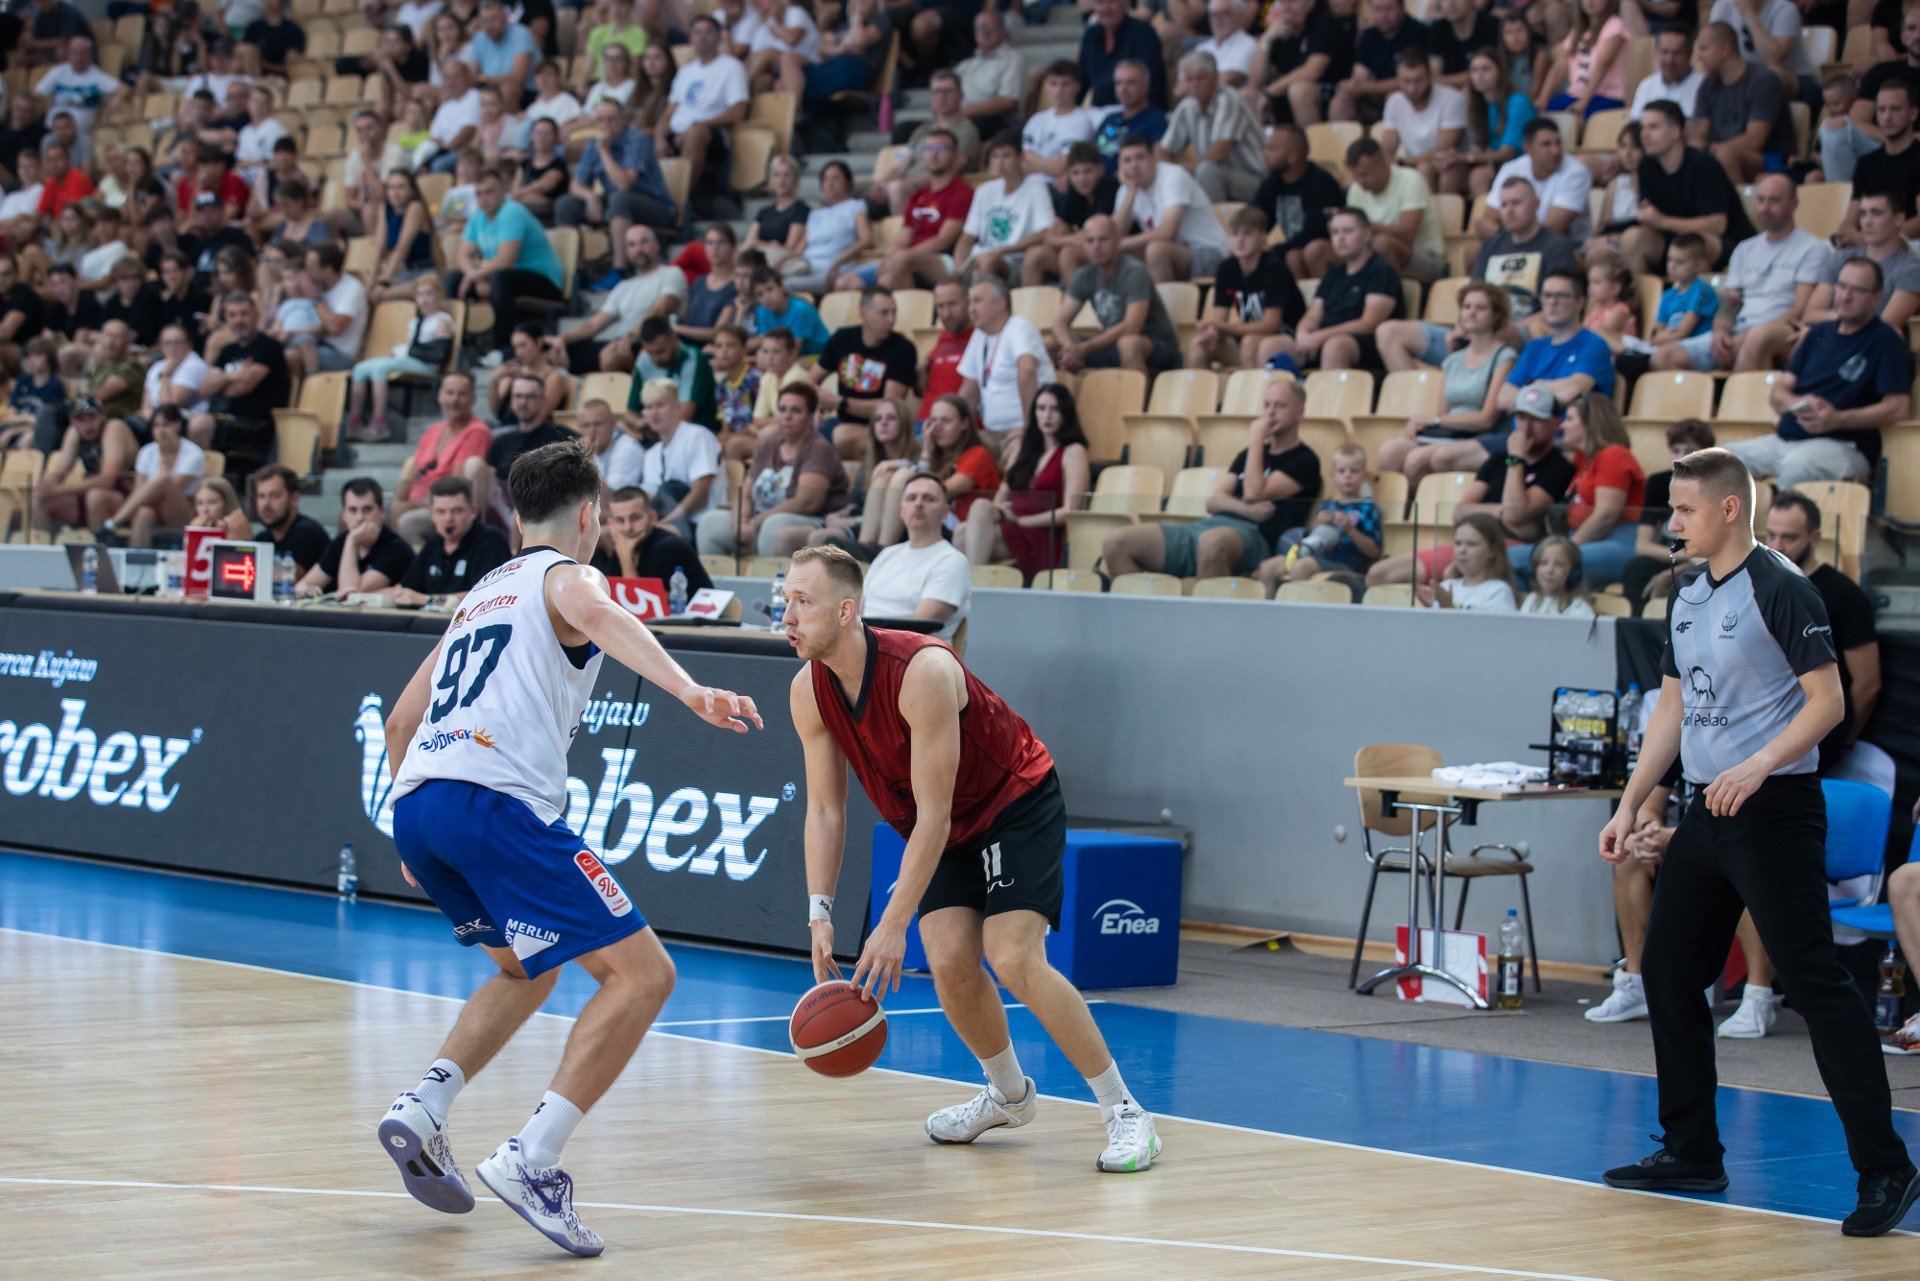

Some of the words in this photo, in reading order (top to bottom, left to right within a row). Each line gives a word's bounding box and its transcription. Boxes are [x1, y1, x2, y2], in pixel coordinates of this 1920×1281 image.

[190, 535, 223, 582] 5
[615, 582, 665, 619] 5
[429, 622, 513, 725] 97
[581, 690, 651, 735] ujaw
[506, 918, 561, 944] MERLIN
[1100, 912, 1160, 935] Enea
